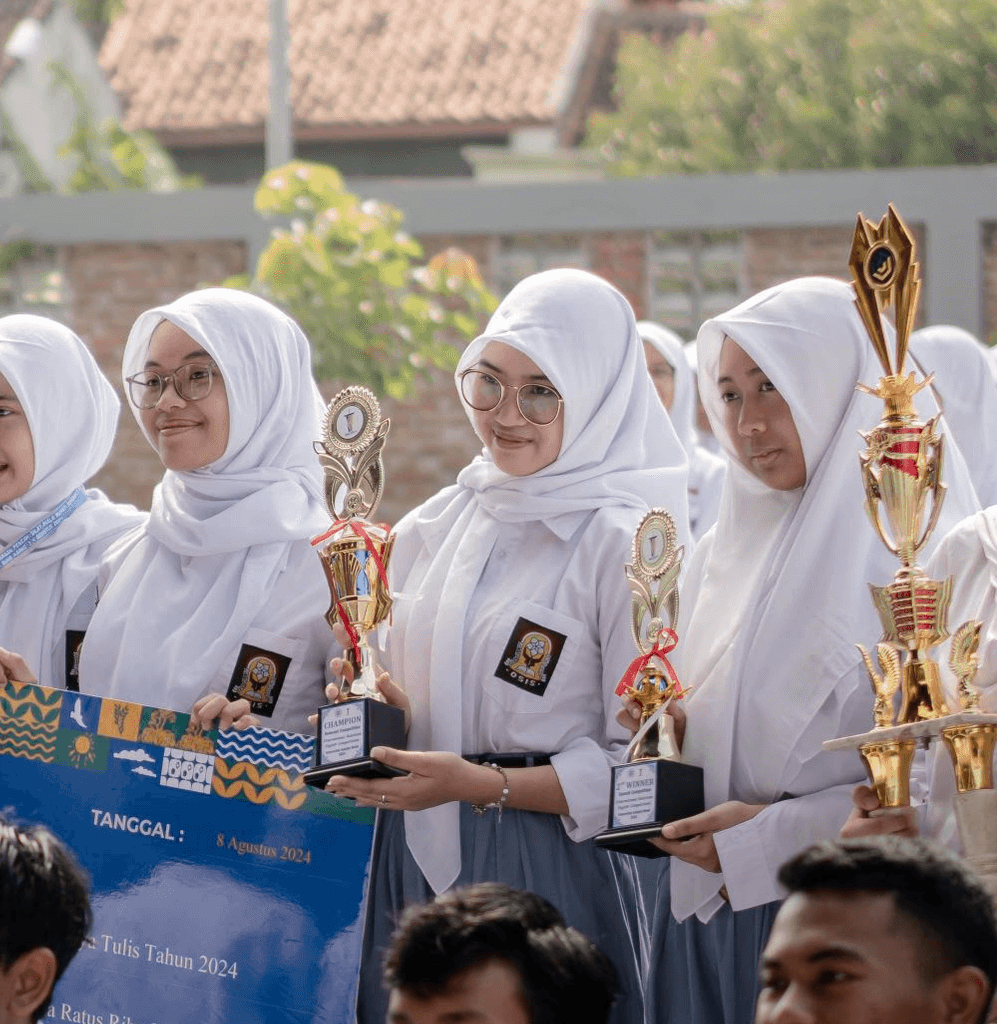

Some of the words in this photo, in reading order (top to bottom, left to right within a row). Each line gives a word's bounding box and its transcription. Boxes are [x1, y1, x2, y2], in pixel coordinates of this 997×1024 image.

[510, 671, 536, 687] OSIS
[324, 716, 362, 729] CHAMPION
[626, 778, 654, 789] WINNER
[91, 808, 175, 841] TANGGAL
[179, 829, 185, 842] :
[216, 833, 224, 847] 8
[228, 836, 278, 858] Agustus
[279, 845, 311, 864] 2024
[101, 934, 140, 959] Tulis
[144, 944, 193, 970] Tahun
[198, 955, 238, 979] 2024
